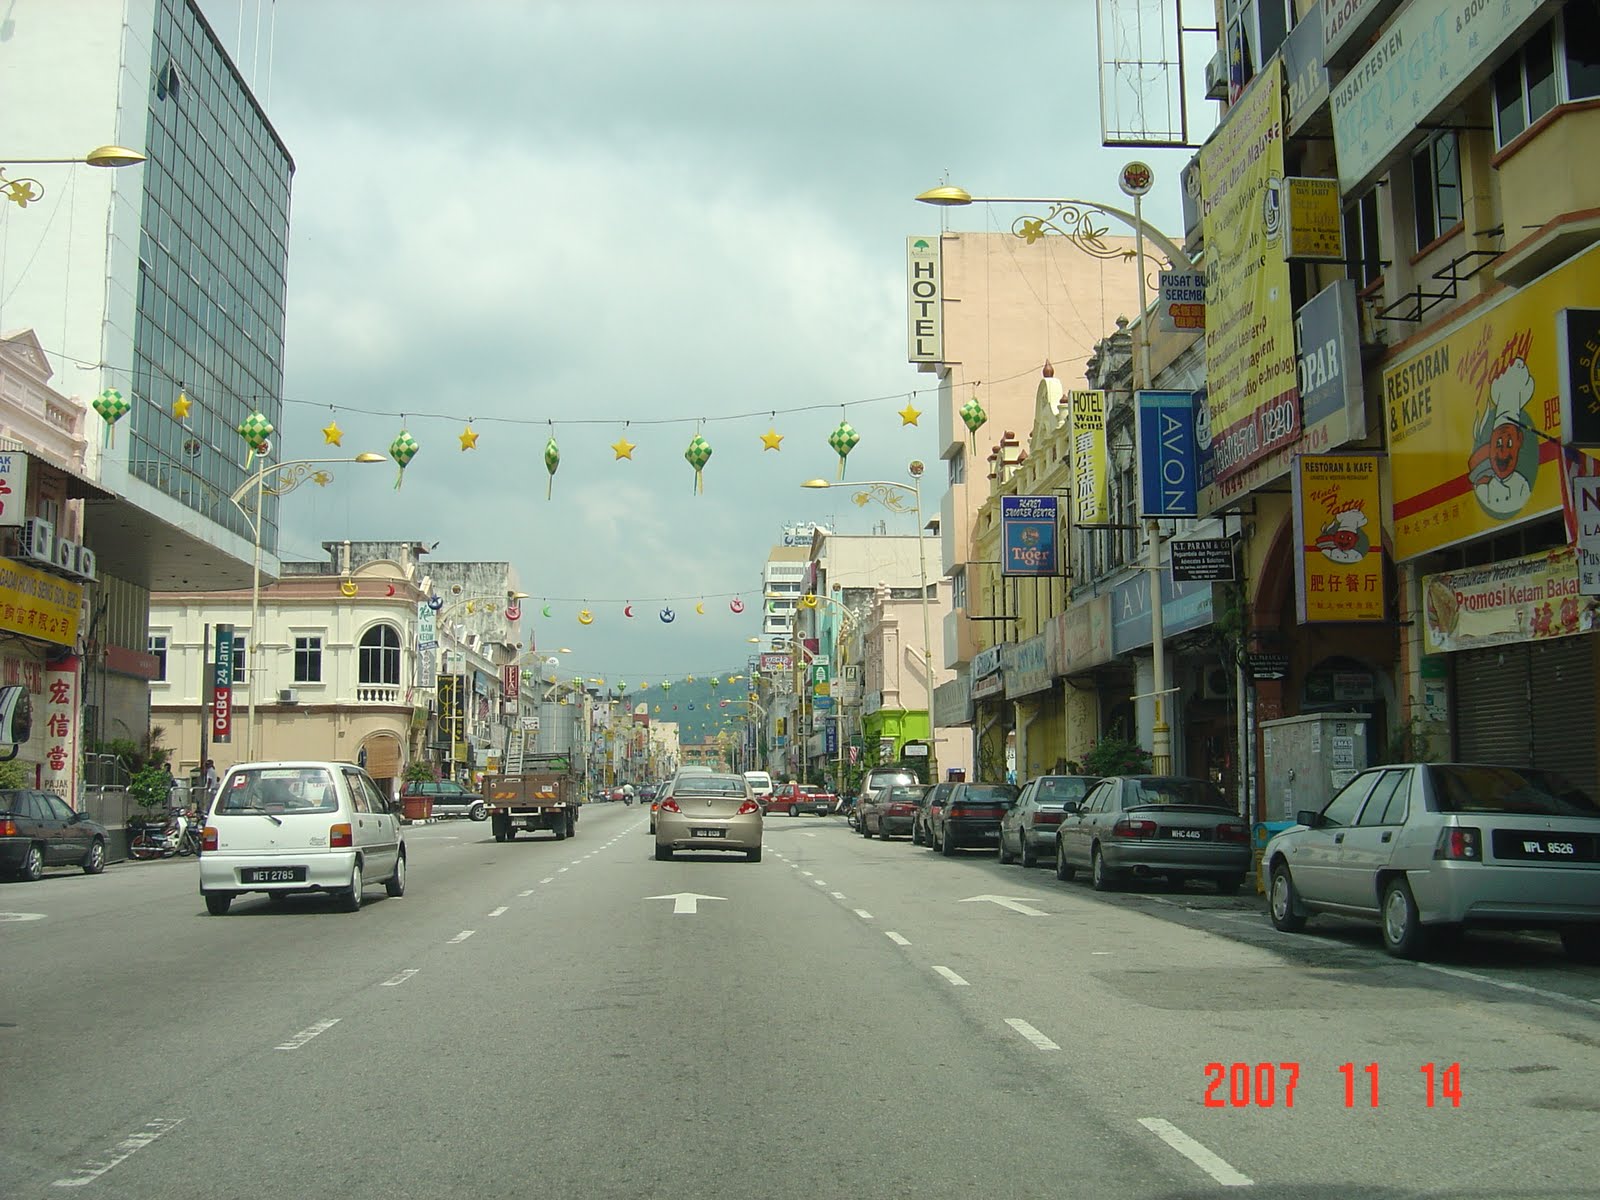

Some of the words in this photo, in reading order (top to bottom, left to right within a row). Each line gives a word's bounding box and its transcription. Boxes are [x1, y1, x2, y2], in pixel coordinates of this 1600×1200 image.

[1325, 0, 1363, 44] LABOR
[1335, 71, 1364, 113] PUSAT
[1365, 30, 1403, 83] FESYEN
[1455, 15, 1462, 34] &
[1161, 275, 1192, 287] PUSAT
[912, 261, 936, 356] HOTEL
[1387, 344, 1450, 403] RESTORAN
[1073, 392, 1102, 413] HOTEL
[1390, 406, 1398, 432] &
[1402, 387, 1433, 427] KAFE
[1074, 422, 1103, 431] Seng
[1075, 414, 1102, 422] Wah
[1261, 401, 1295, 446] 1220
[1162, 413, 1186, 511] AVON
[1305, 462, 1344, 473] RESTORAN
[1346, 462, 1351, 473] &
[1353, 462, 1373, 473] KAFE
[1075, 431, 1097, 522] 華生旅店
[1310, 483, 1341, 501] Uncle
[1033, 508, 1056, 518] CENTRE
[1321, 494, 1366, 516] Fatty
[1187, 542, 1212, 550] PARAM
[1012, 547, 1049, 566] Tiger
[1310, 573, 1378, 593] 肥仔餐厅
[1456, 583, 1507, 610] Promosi
[1509, 584, 1544, 605] Ketam
[421, 624, 433, 632] NAM
[219, 641, 229, 667] Jam
[217, 670, 228, 685] 24
[216, 691, 228, 730] OCBC
[46, 678, 70, 771] 宏信當
[44, 779, 69, 789] PAJAK
[233, 775, 246, 787] P
[47, 789, 68, 798] ADAI
[1523, 841, 1545, 853] WPL
[1547, 842, 1574, 854] 8526
[253, 871, 269, 881] WET
[271, 871, 294, 881] 2785
